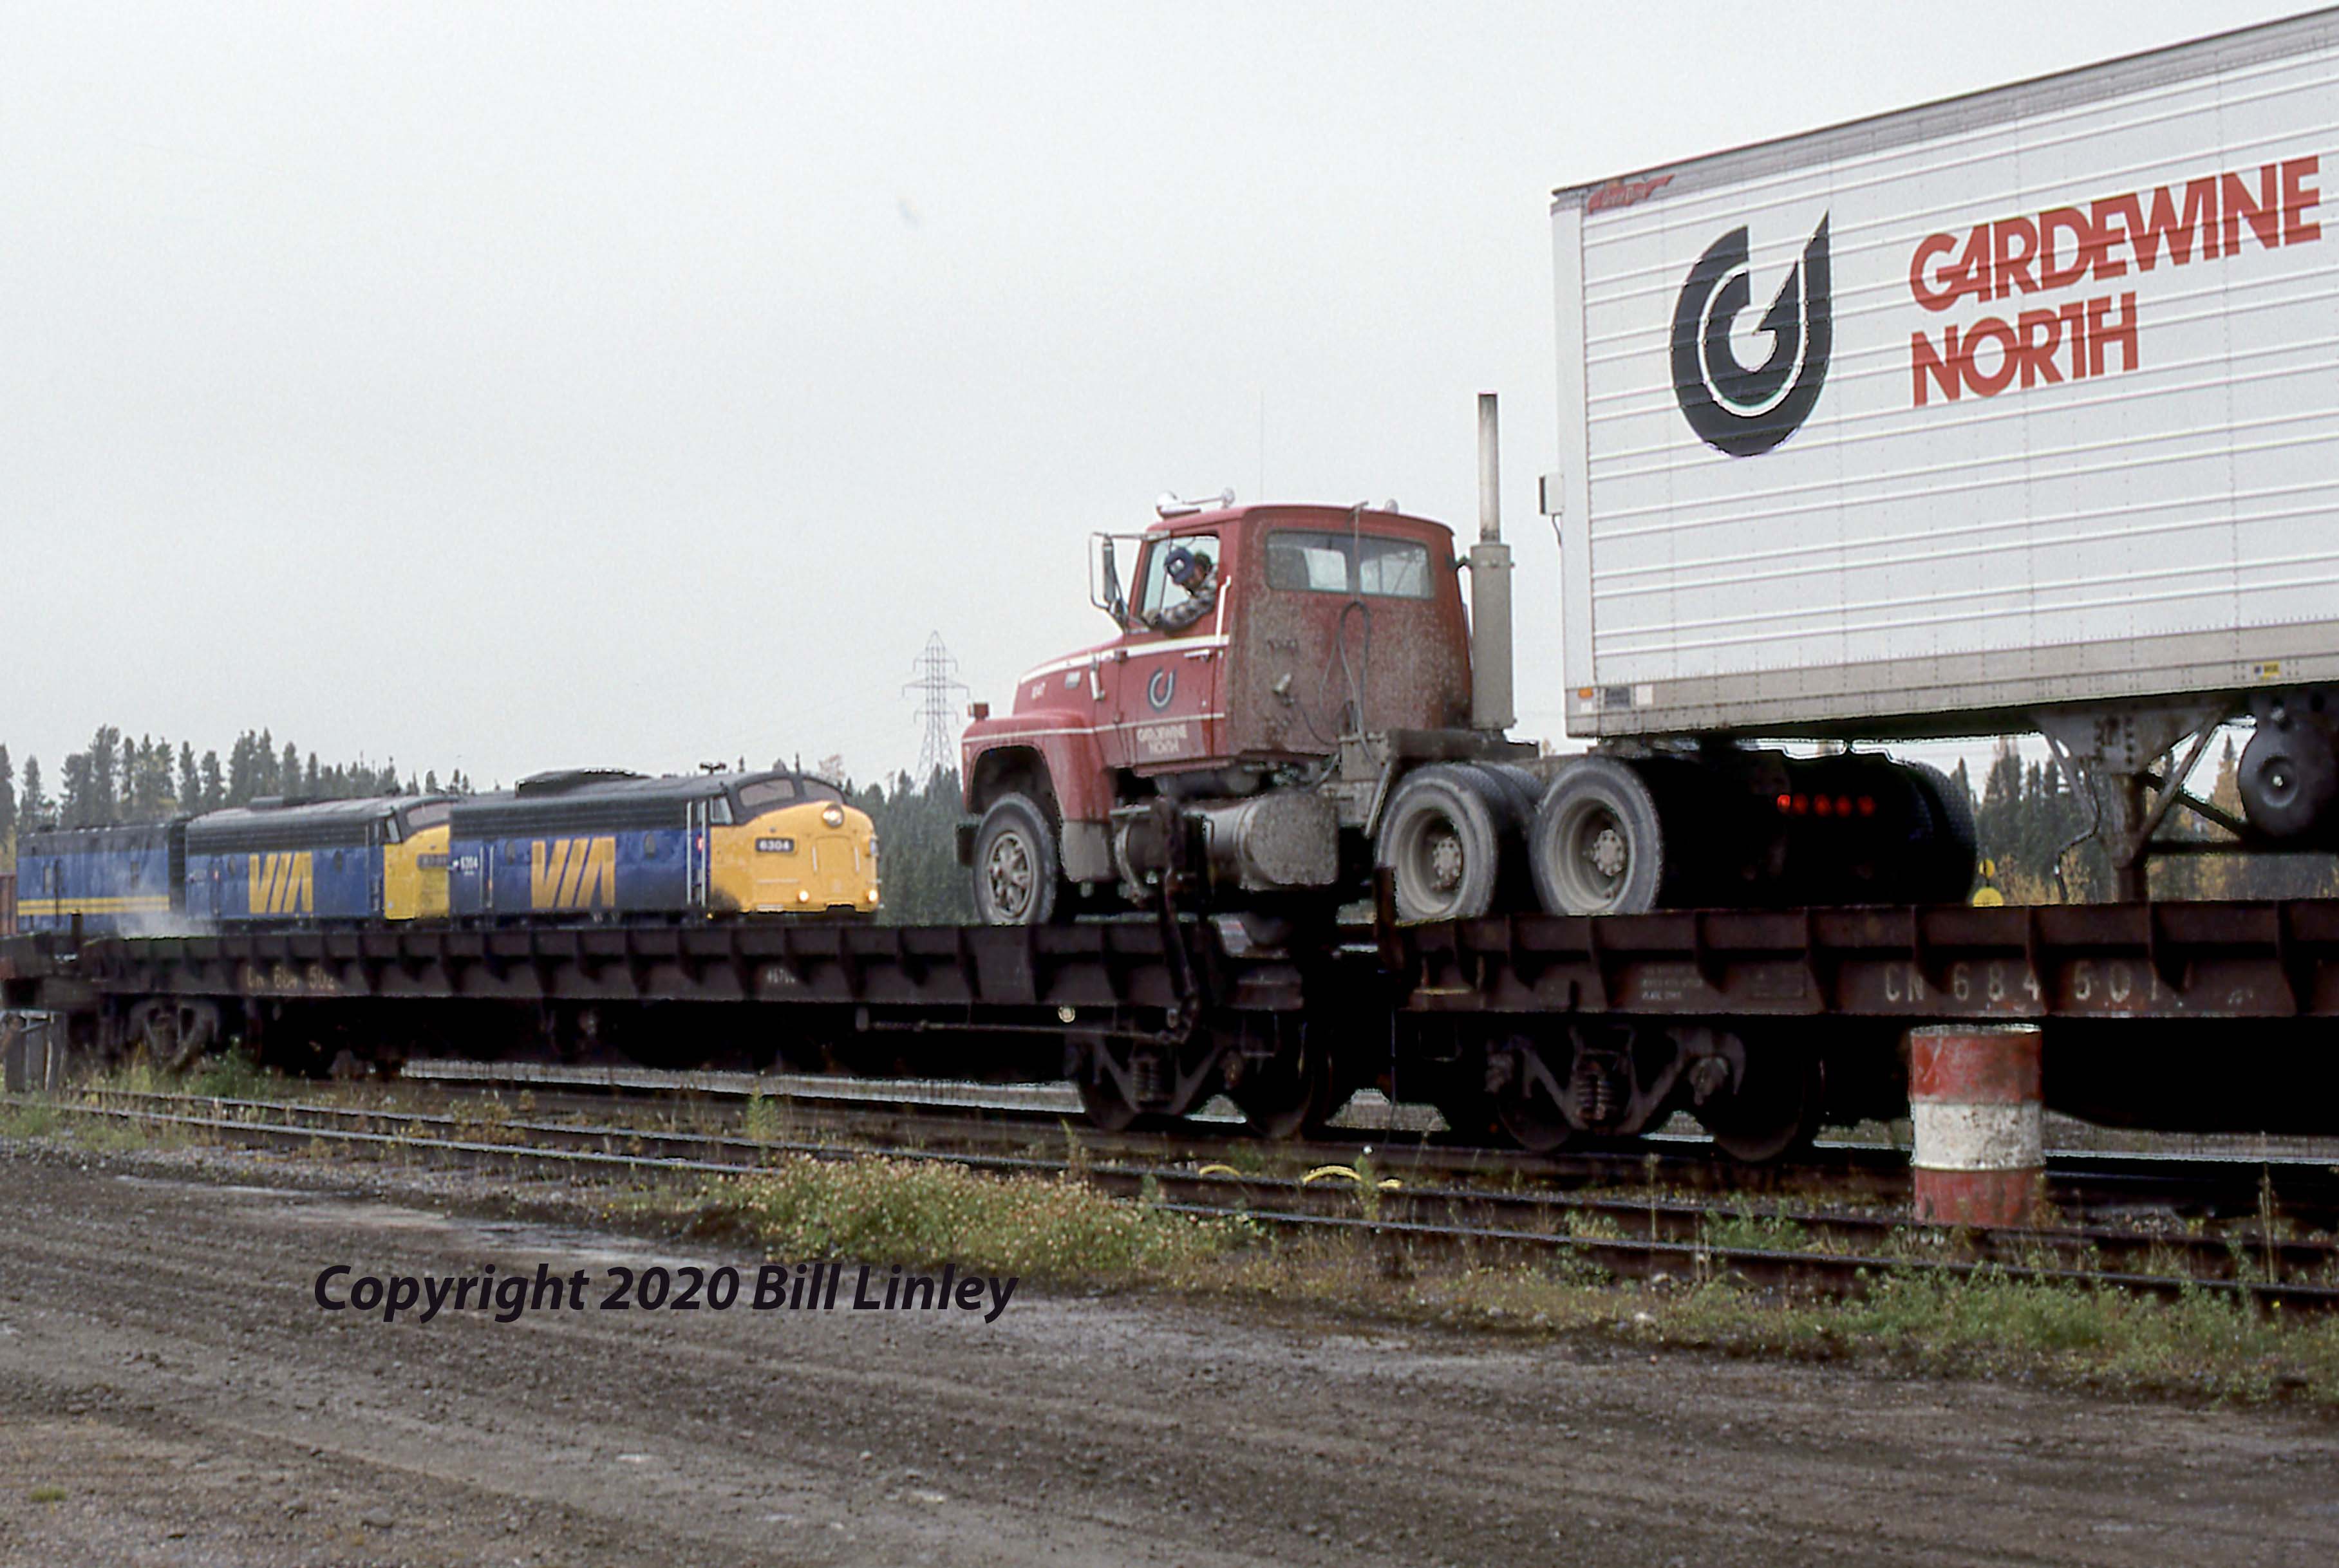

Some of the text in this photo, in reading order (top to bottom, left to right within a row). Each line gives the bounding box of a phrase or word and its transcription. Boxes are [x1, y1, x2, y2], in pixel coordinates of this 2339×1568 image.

[1910, 155, 2320, 312] GARDEWINE
[1912, 292, 2138, 406] NORTH
[531, 837, 615, 908] VIA
[760, 839, 790, 851] 6304
[249, 852, 313, 913] VIA
